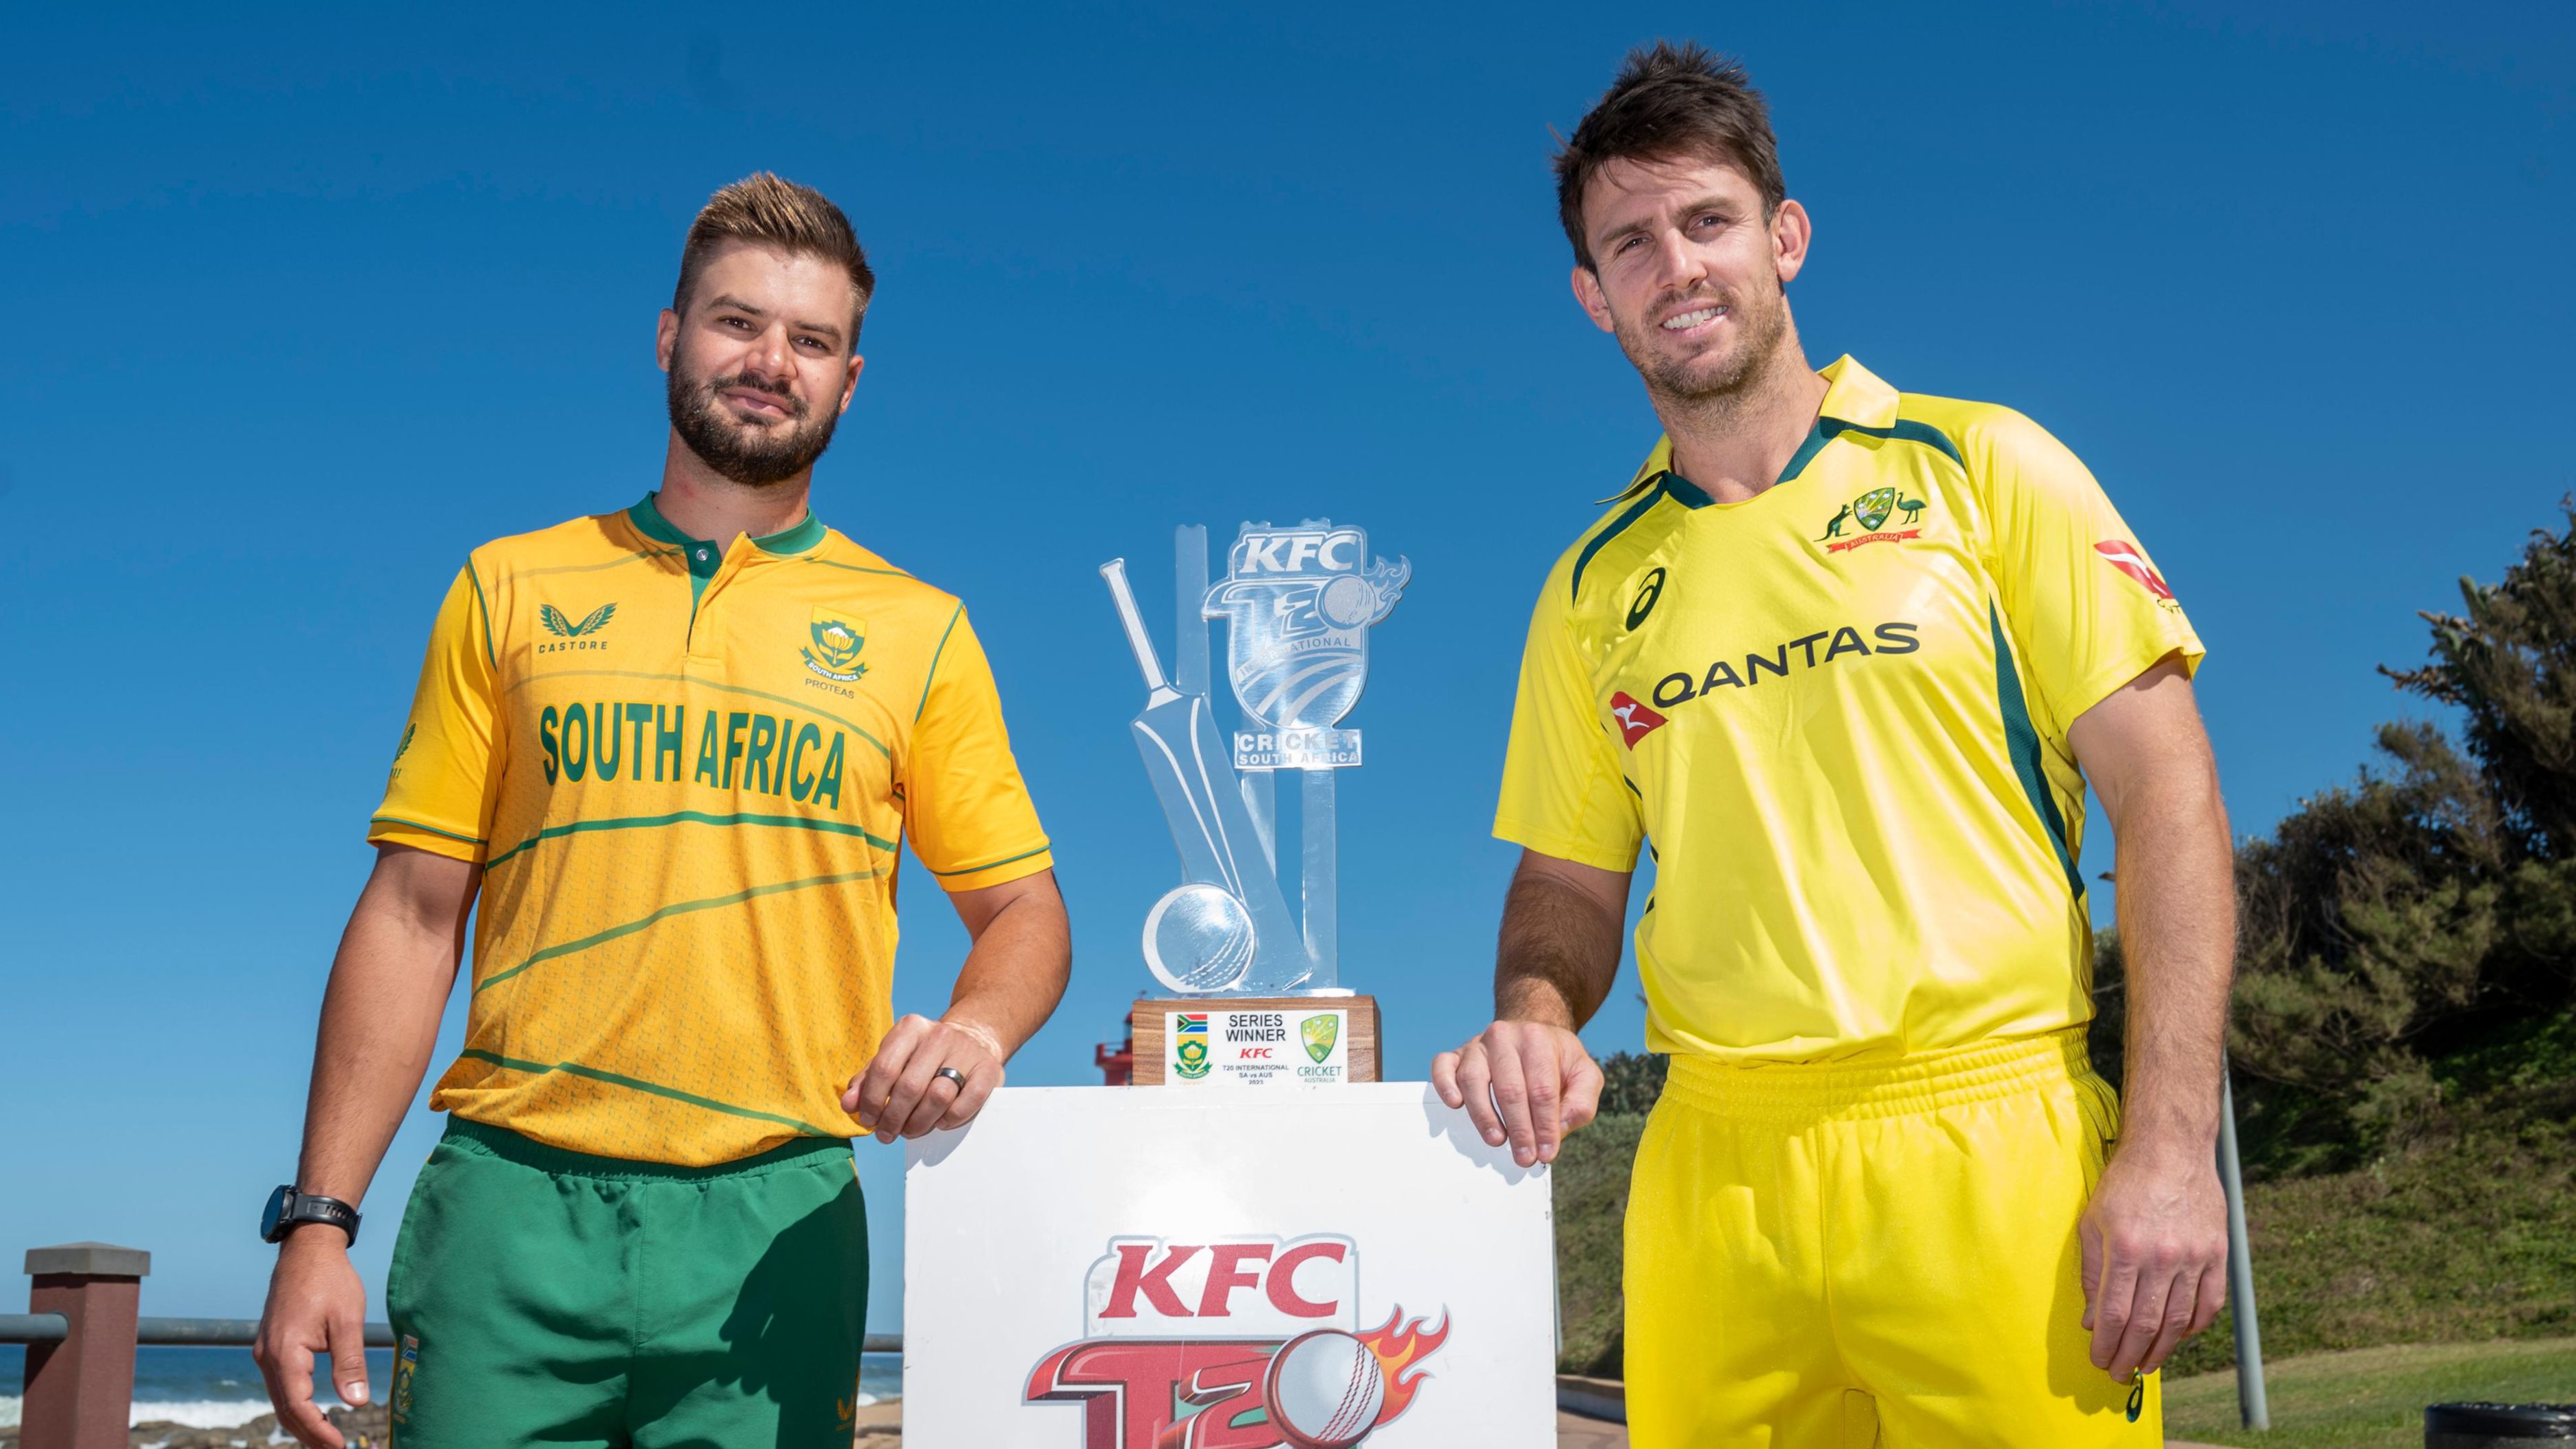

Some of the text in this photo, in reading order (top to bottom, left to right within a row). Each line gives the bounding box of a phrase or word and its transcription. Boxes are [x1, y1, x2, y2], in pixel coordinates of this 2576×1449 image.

[1850, 532, 1898, 547] AUSTRALIA
[1242, 536, 1356, 573] KFC
[538, 640, 608, 653] CASTORE
[808, 662, 832, 678] SOUTH
[1652, 622, 1920, 708] QANTAS
[805, 679, 855, 699] PROTEAS
[1238, 732, 1359, 752] CRICKET
[540, 702, 845, 811] SOUTH AFRICA
[1239, 751, 1359, 765] SOUTH AFRICA
[1229, 1014, 1283, 1027] SERIES
[1226, 1029, 1286, 1042] WINNER
[1239, 1048, 1273, 1059] KFC
[1297, 1066, 1342, 1076] CRICKET
[1098, 1242, 1347, 1318] KFC
